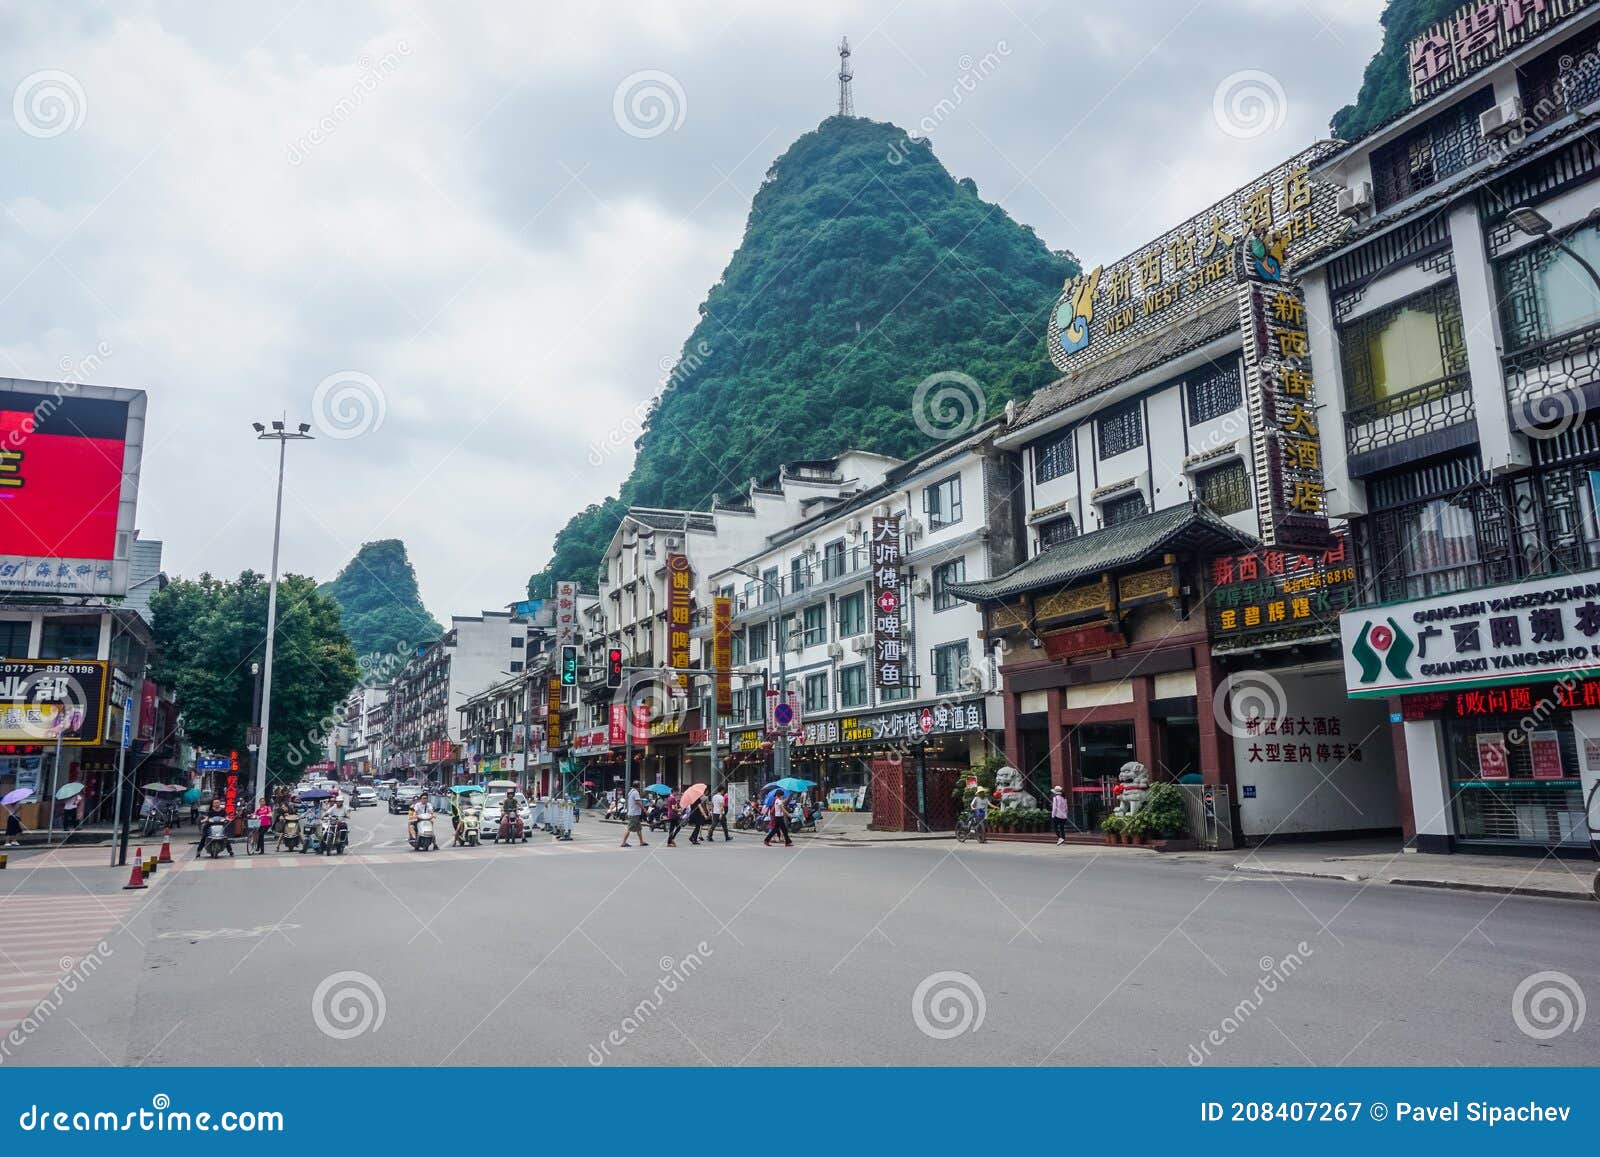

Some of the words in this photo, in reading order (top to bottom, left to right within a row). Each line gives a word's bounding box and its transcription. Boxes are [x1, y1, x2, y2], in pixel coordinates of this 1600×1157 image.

[1106, 166, 1312, 306] 新西街大酒店
[1105, 307, 1135, 335] NEW
[1142, 281, 1181, 316] WEST
[1188, 254, 1234, 293] STREE
[1284, 211, 1318, 241] TEL
[1271, 291, 1323, 512] 新西街大酒店
[875, 519, 899, 589] 大师傅
[1220, 597, 1311, 630] 金碧辉煌
[877, 614, 900, 686] 啤酒鱼
[1420, 656, 1489, 677] GUANGXI
[0, 676, 69, 701] 业部
[0, 708, 42, 723] 景区
[878, 712, 919, 738] 大师傅
[934, 704, 981, 732] 啤酒鱼
[1246, 716, 1341, 736] 新西街大酒店
[1248, 743, 1362, 763] 大型室内停车场
